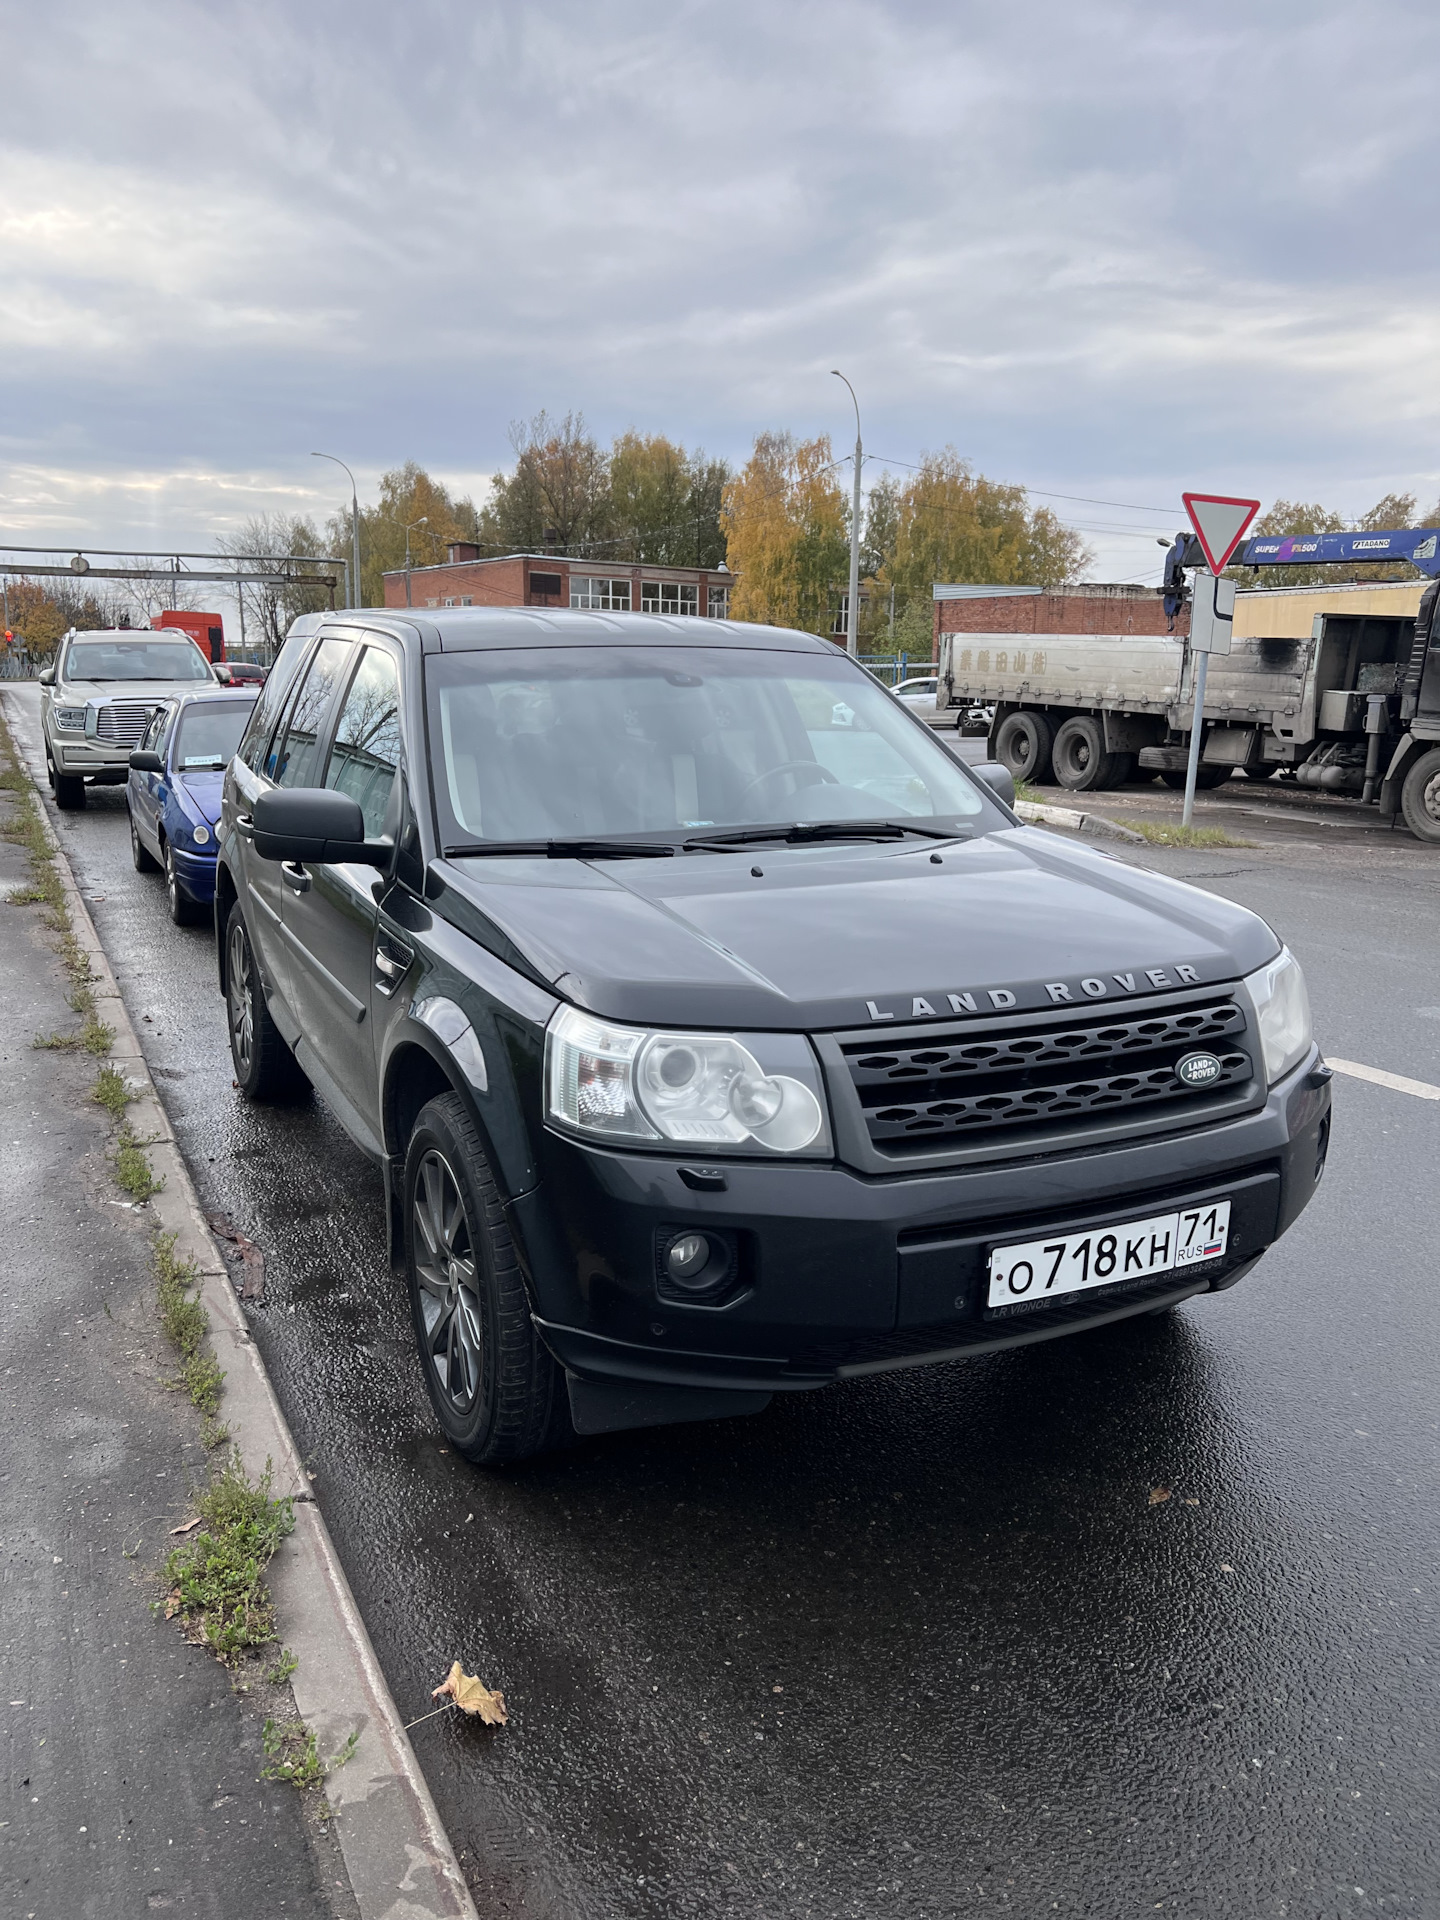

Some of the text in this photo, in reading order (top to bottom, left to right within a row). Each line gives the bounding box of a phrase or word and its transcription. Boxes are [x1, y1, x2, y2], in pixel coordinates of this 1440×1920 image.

[1255, 545, 1280, 554] SUPER
[1361, 540, 1390, 548] TADANO
[865, 964, 1202, 1021] LAND ROVER
[1188, 1059, 1208, 1072] LAND
[1191, 1066, 1216, 1080] ROVER
[1184, 1209, 1218, 1247] 71
[1177, 1244, 1203, 1262] RUS
[991, 1298, 1052, 1319] LR VIDNOE
